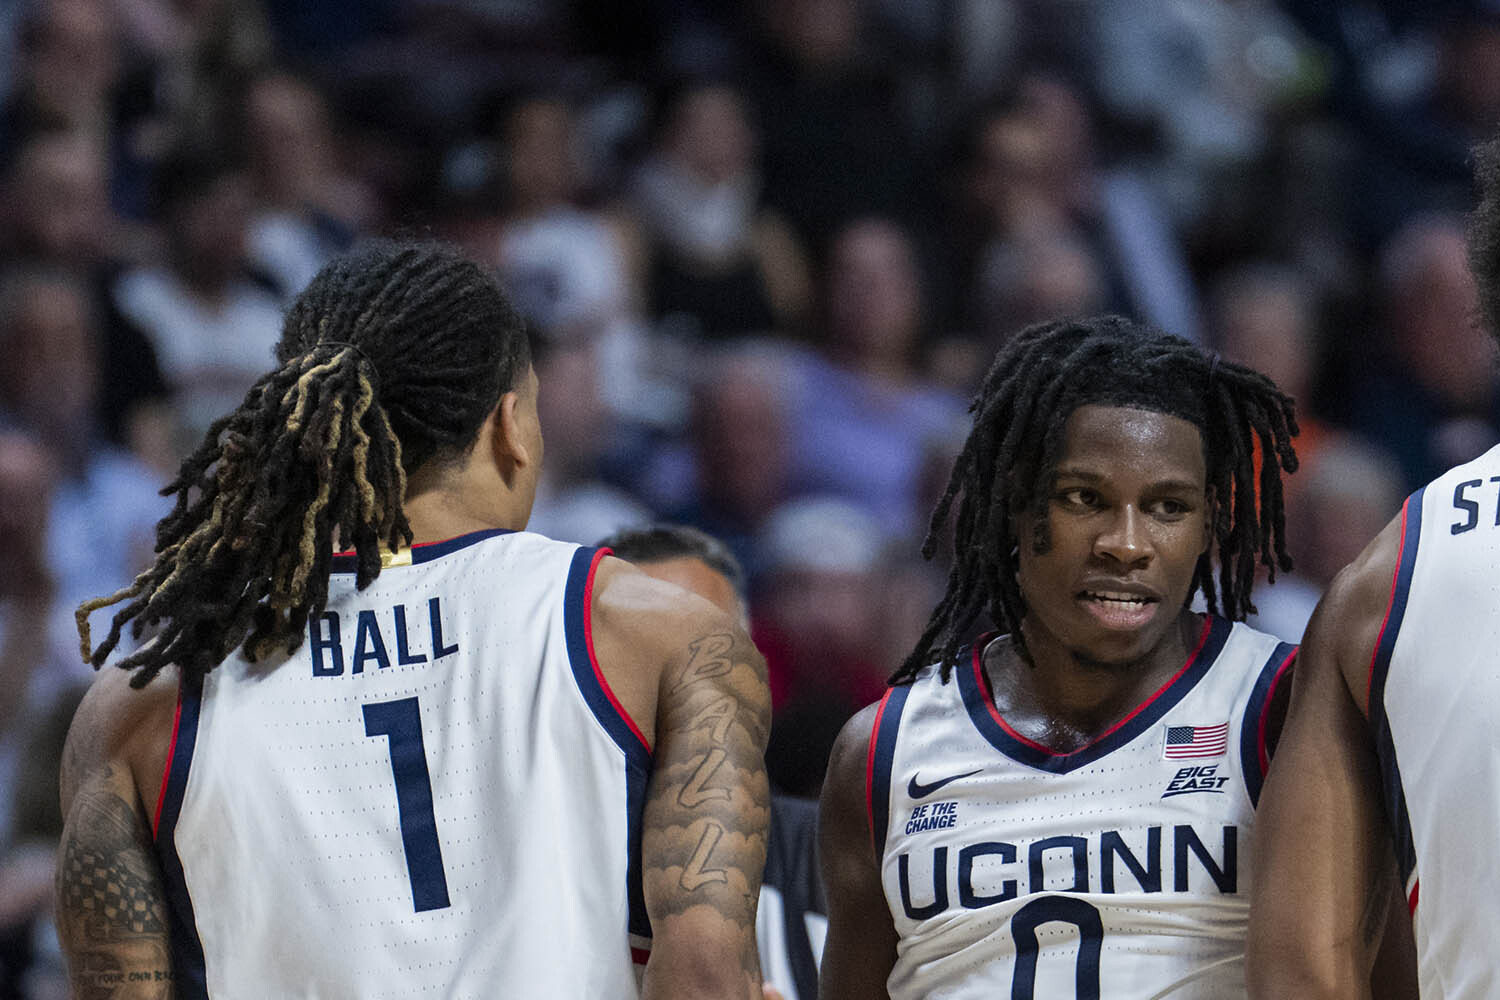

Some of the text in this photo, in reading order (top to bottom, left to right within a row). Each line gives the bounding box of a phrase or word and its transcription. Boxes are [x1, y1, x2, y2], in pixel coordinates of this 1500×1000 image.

[310, 597, 459, 677] BALL
[1178, 765, 1217, 778] BIG
[1168, 777, 1229, 789] EAST
[362, 696, 451, 913] 1
[911, 802, 958, 818] BE THE
[905, 815, 957, 834] CHANGE
[898, 826, 1237, 921] UCONN
